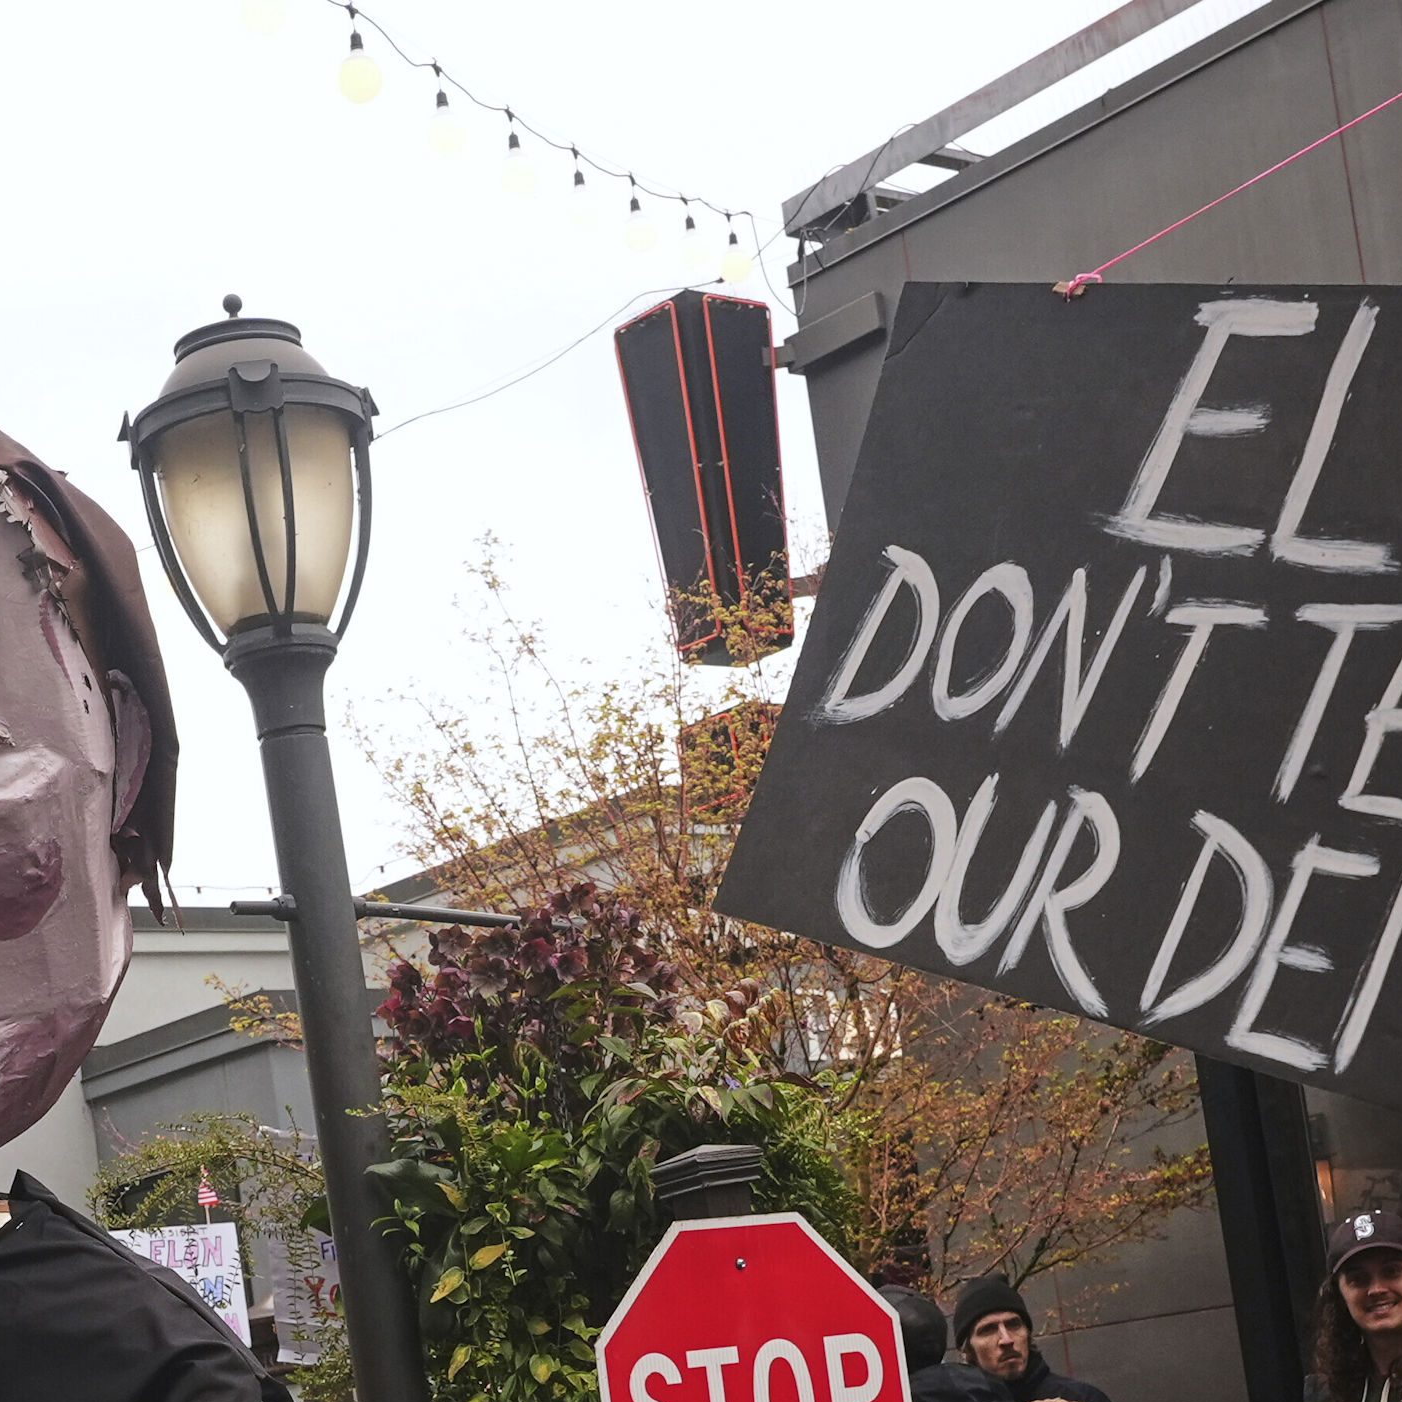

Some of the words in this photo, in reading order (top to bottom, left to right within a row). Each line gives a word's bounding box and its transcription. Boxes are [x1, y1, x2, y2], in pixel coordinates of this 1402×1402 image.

[816, 545, 1268, 784] DON'T
[837, 773, 1121, 1018] OUR
[150, 1235, 223, 1268] ELON
